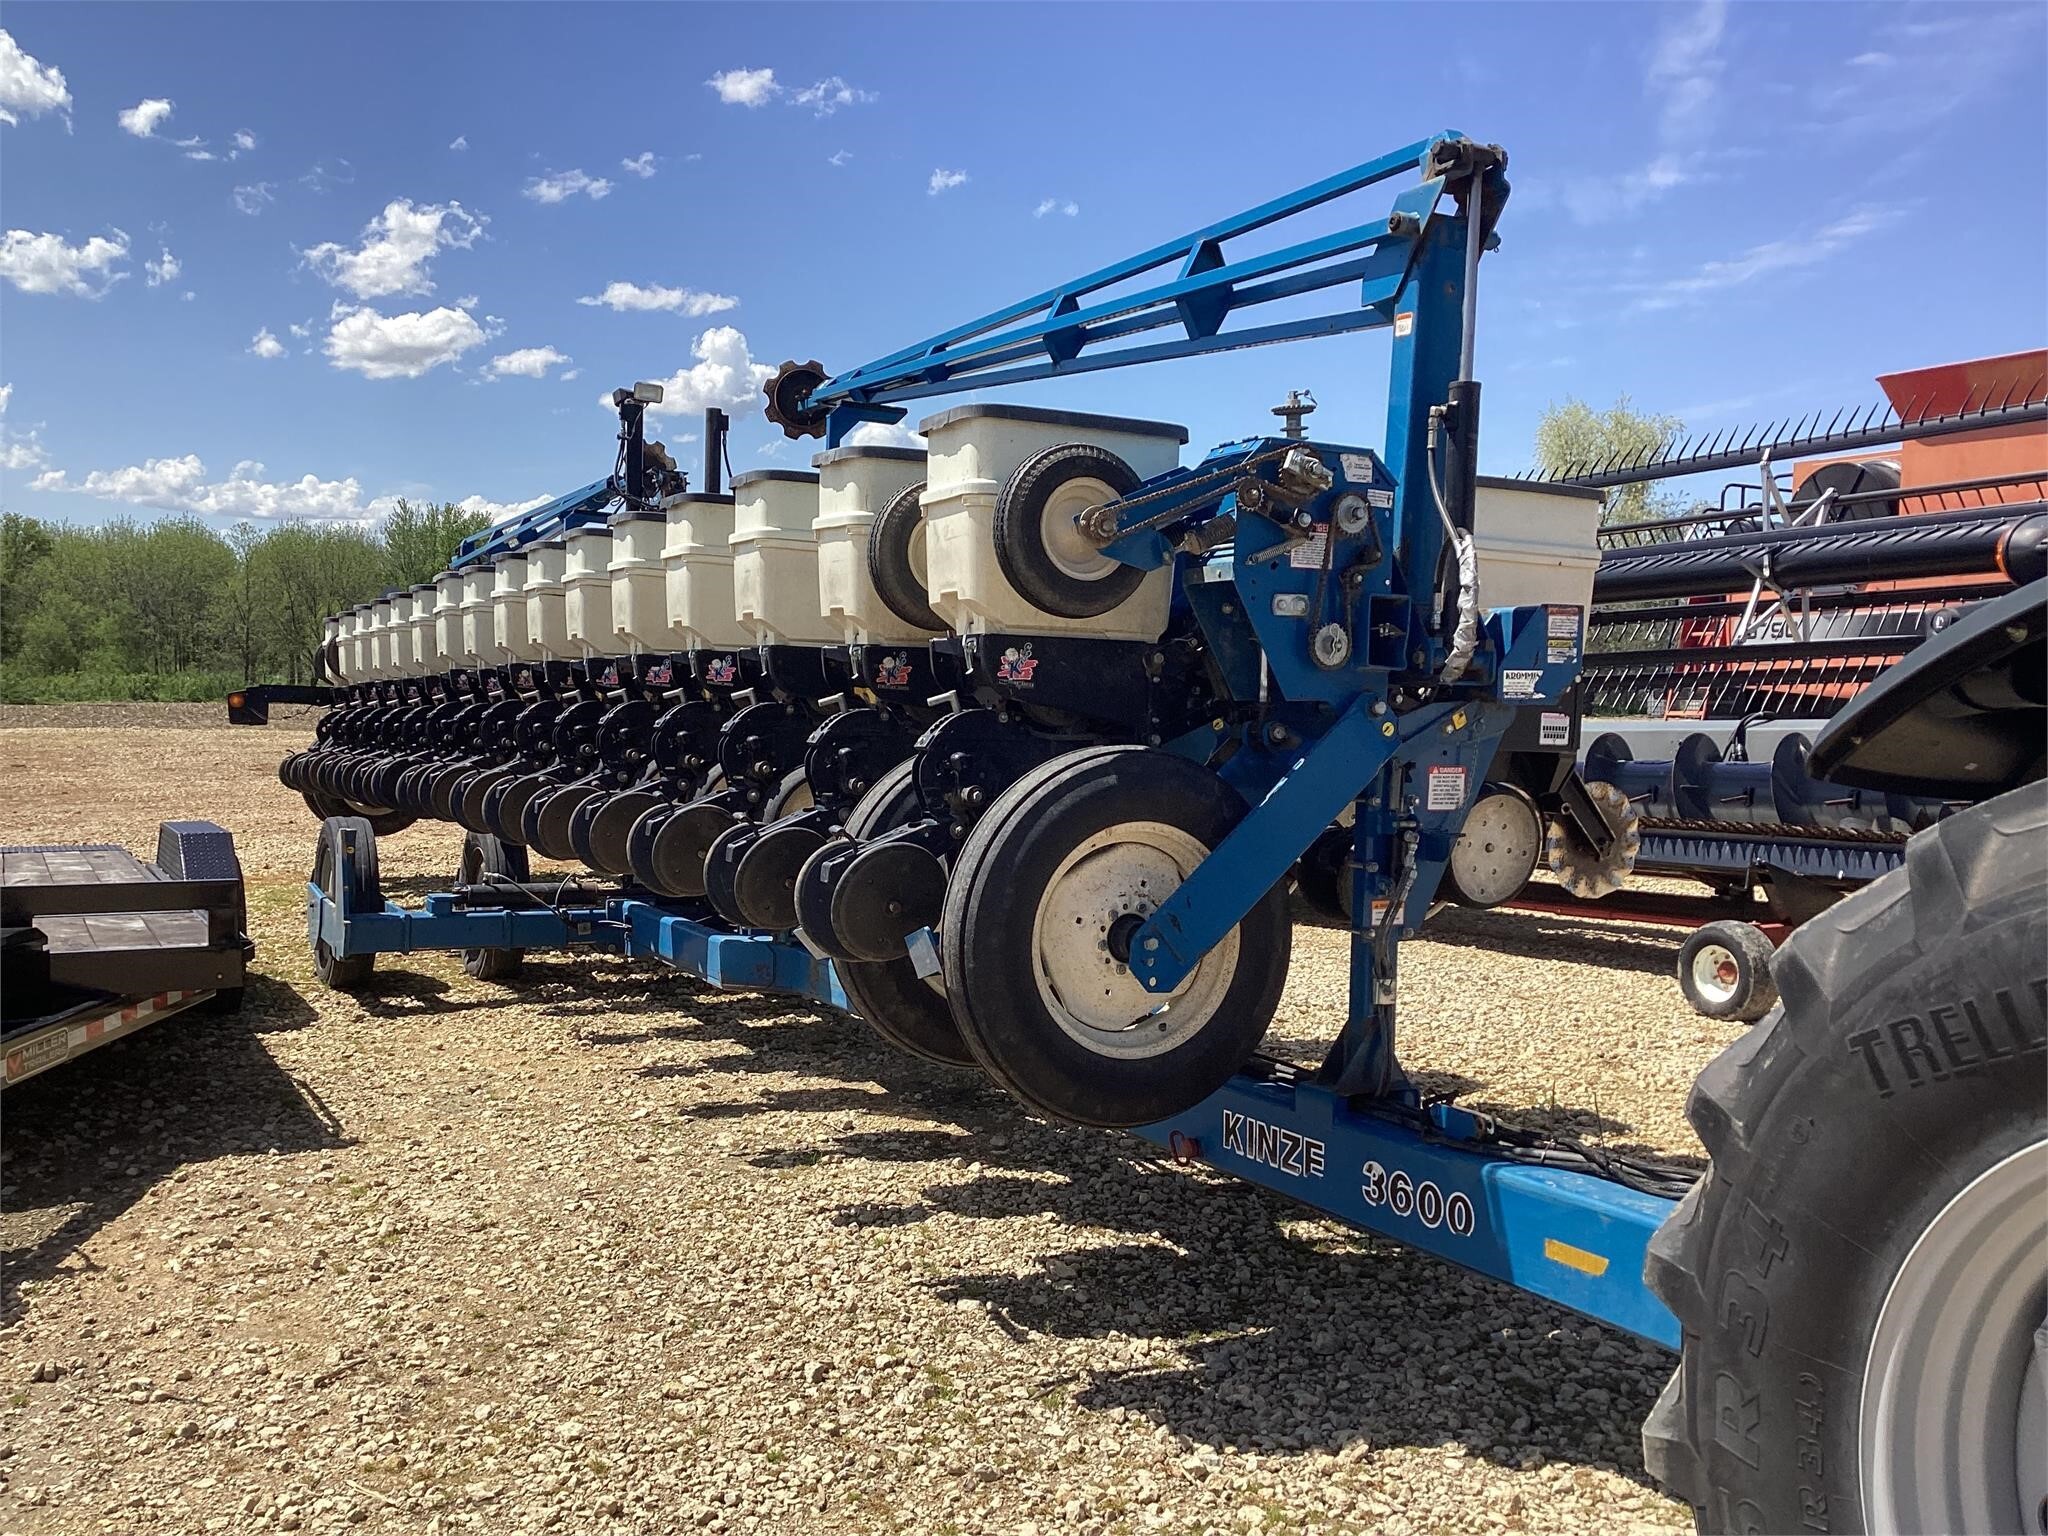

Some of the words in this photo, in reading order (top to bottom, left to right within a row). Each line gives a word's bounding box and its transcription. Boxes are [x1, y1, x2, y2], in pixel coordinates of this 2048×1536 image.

[22, 1031, 67, 1061] MILLER
[1223, 1109, 1325, 1178] KINZE
[1361, 1160, 1475, 1237] 3600
